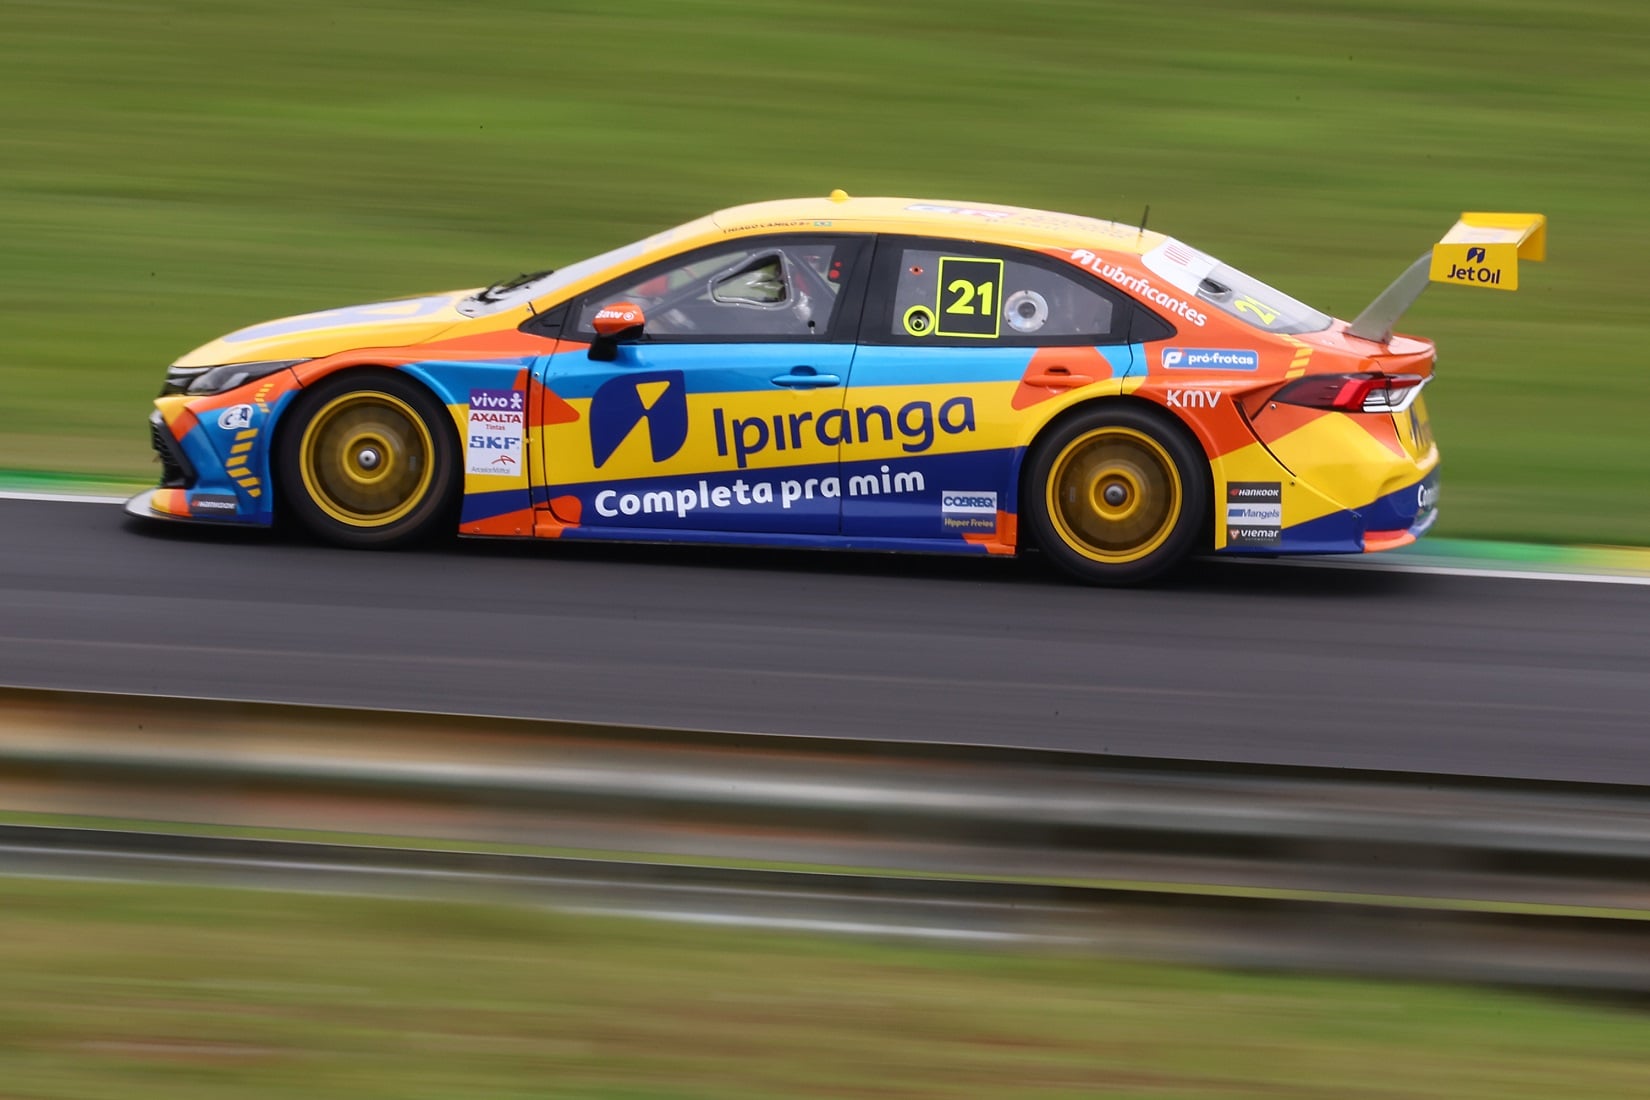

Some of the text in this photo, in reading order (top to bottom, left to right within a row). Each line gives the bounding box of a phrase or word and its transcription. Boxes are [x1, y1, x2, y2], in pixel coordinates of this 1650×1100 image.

[1447, 264, 1501, 284] Jet Oil
[946, 279, 993, 316] 21
[1092, 258, 1207, 327] Lubrificantes
[471, 392, 508, 408] vivo
[1166, 389, 1221, 408] KMV
[470, 412, 521, 423] AXALTA
[713, 396, 976, 469] Ipiranga
[469, 435, 520, 450] SKF
[595, 465, 925, 518] Completa pra mim
[944, 496, 994, 508] COBREQ
[1241, 508, 1280, 519] Mangels
